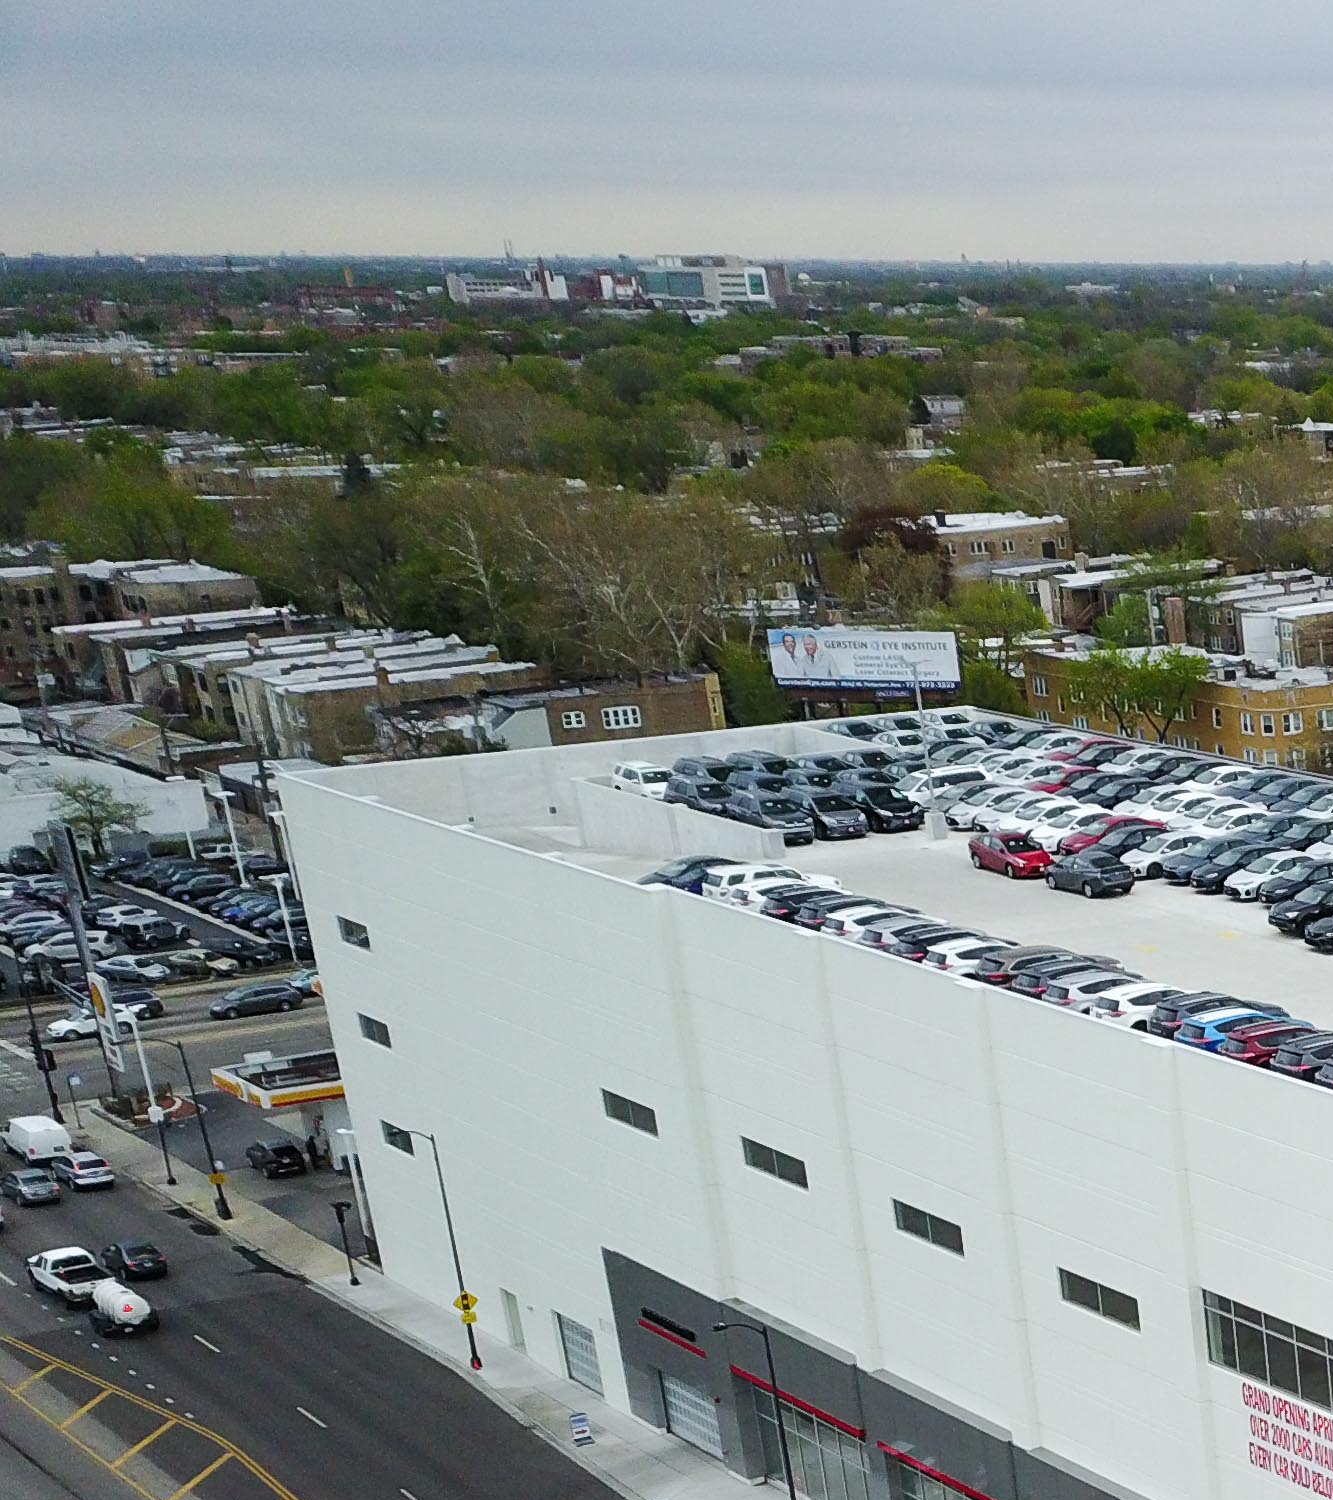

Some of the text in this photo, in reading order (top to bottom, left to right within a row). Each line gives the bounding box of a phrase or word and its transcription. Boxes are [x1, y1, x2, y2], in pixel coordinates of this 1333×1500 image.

[824, 640, 948, 650] GERSTEIN EYE INSTITUTE
[1242, 1382, 1270, 1415] GRAND
[1272, 1395, 1310, 1432] OPENING
[1250, 1414, 1270, 1442] OVER
[1272, 1423, 1290, 1452] 2000
[1292, 1432, 1312, 1462] CARS
[1249, 1442, 1272, 1472] EVERY
[1274, 1453, 1290, 1480] CAR
[1290, 1460, 1310, 1489] SOLD
